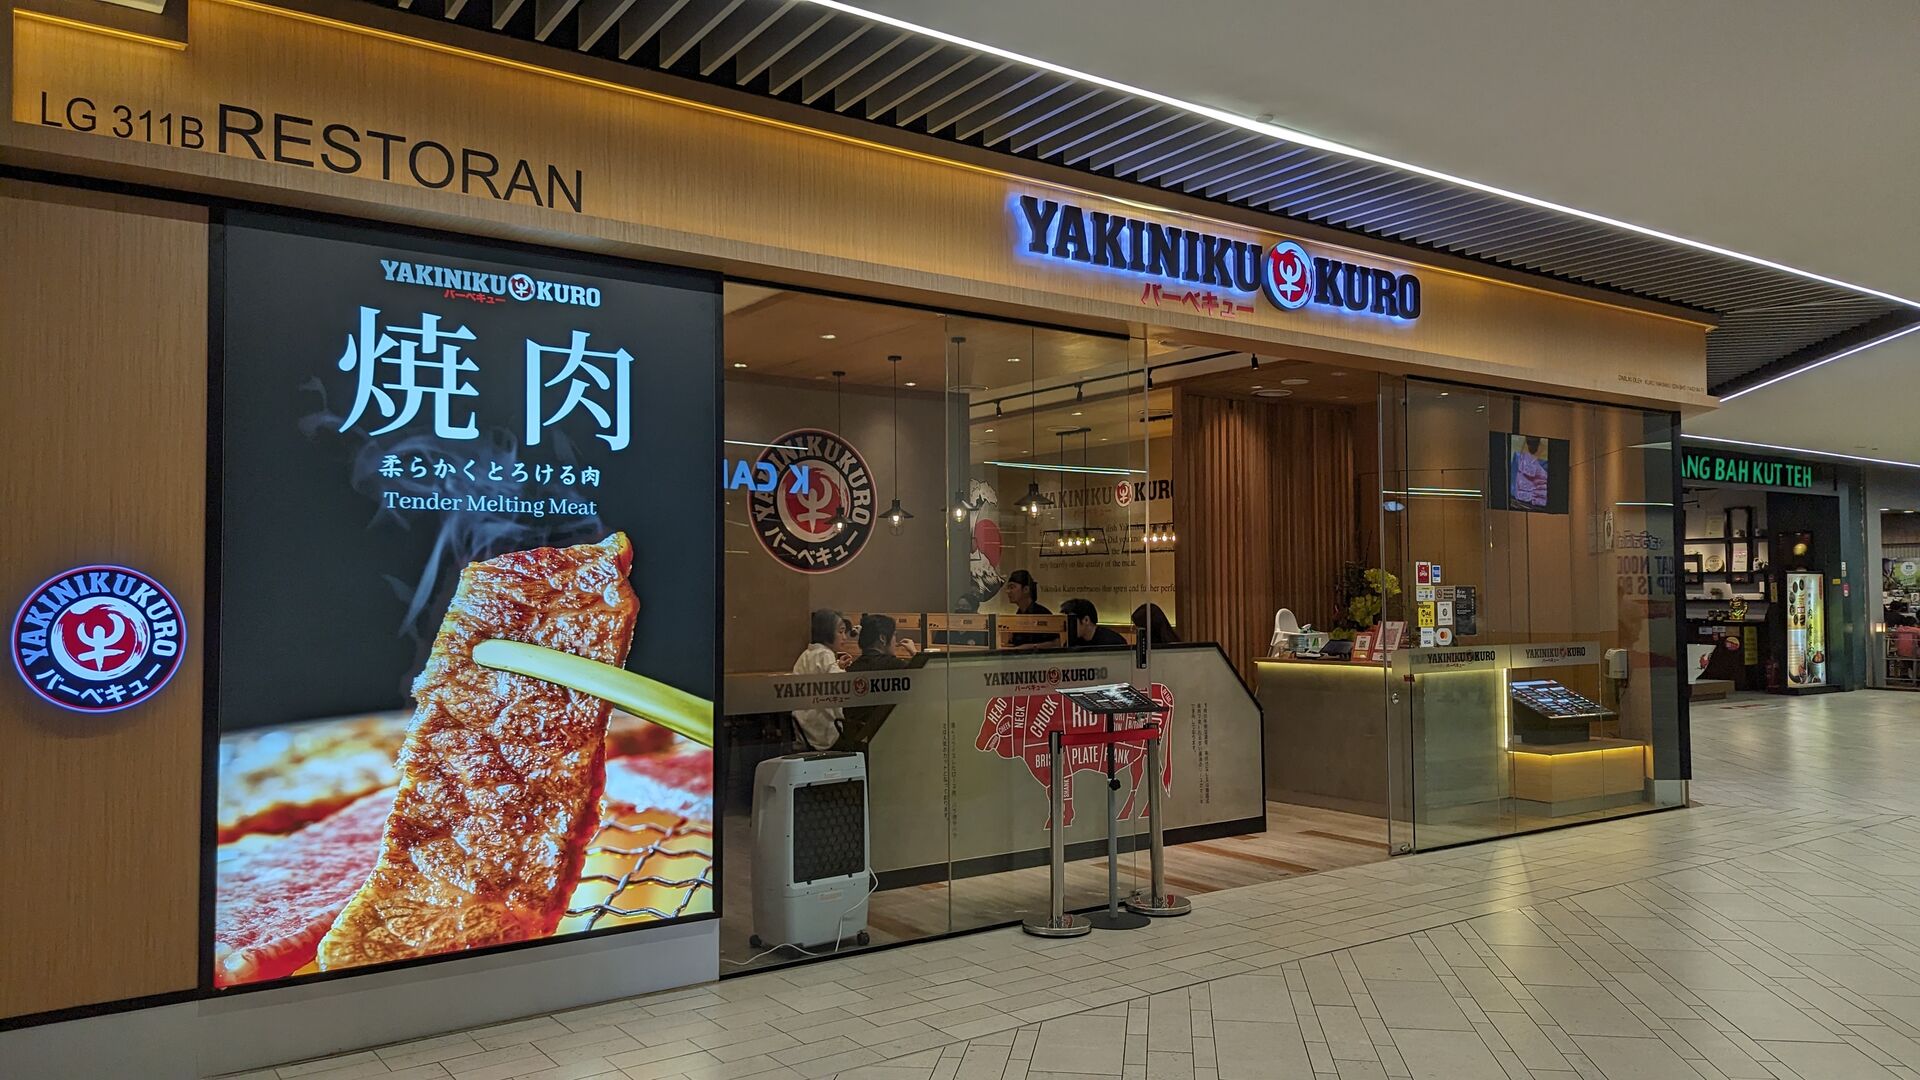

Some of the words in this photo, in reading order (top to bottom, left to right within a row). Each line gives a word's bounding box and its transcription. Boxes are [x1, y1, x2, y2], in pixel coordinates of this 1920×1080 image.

[41, 91, 97, 132] LG
[112, 105, 205, 149] 311B
[218, 103, 582, 213] RESTORAN
[1019, 195, 1263, 292] YAKINIKU
[1313, 256, 1421, 320] KURO
[380, 259, 507, 295] YAKINIKU
[536, 280, 600, 308] KURO
[1140, 283, 1255, 319] バーベキュー
[338, 306, 634, 450] 焼肉
[378, 455, 601, 487] 柔らかくとろける肉
[1714, 457, 1748, 483] BAH
[1752, 461, 1782, 485] KUT
[1785, 464, 1812, 488] TEH
[384, 491, 462, 511] Tender
[466, 494, 544, 517] Melting
[549, 498, 598, 515] Meat
[1134, 479, 1174, 502] KUR
[764, 526, 859, 566] バーベキュー
[1140, 583, 1159, 592] fuher
[20, 571, 178, 666] YAKINIKUKURO
[1427, 651, 1466, 664] YAKINIKU
[1474, 650, 1496, 662] KURO
[1525, 647, 1560, 659] YAKINIKU
[1566, 646, 1586, 657] KURO
[35, 663, 162, 705] バーベキュー
[774, 680, 850, 698] YAKINIKU
[869, 676, 911, 693] KURO
[984, 671, 1047, 687] YAKINIKU
[1061, 667, 1096, 682] KURO
[987, 697, 1008, 725] HEAD
[1014, 705, 1026, 729] NECK
[1030, 694, 1059, 738] CHUCK
[1072, 745, 1099, 765] PLATE
[1103, 746, 1130, 764] FANK
